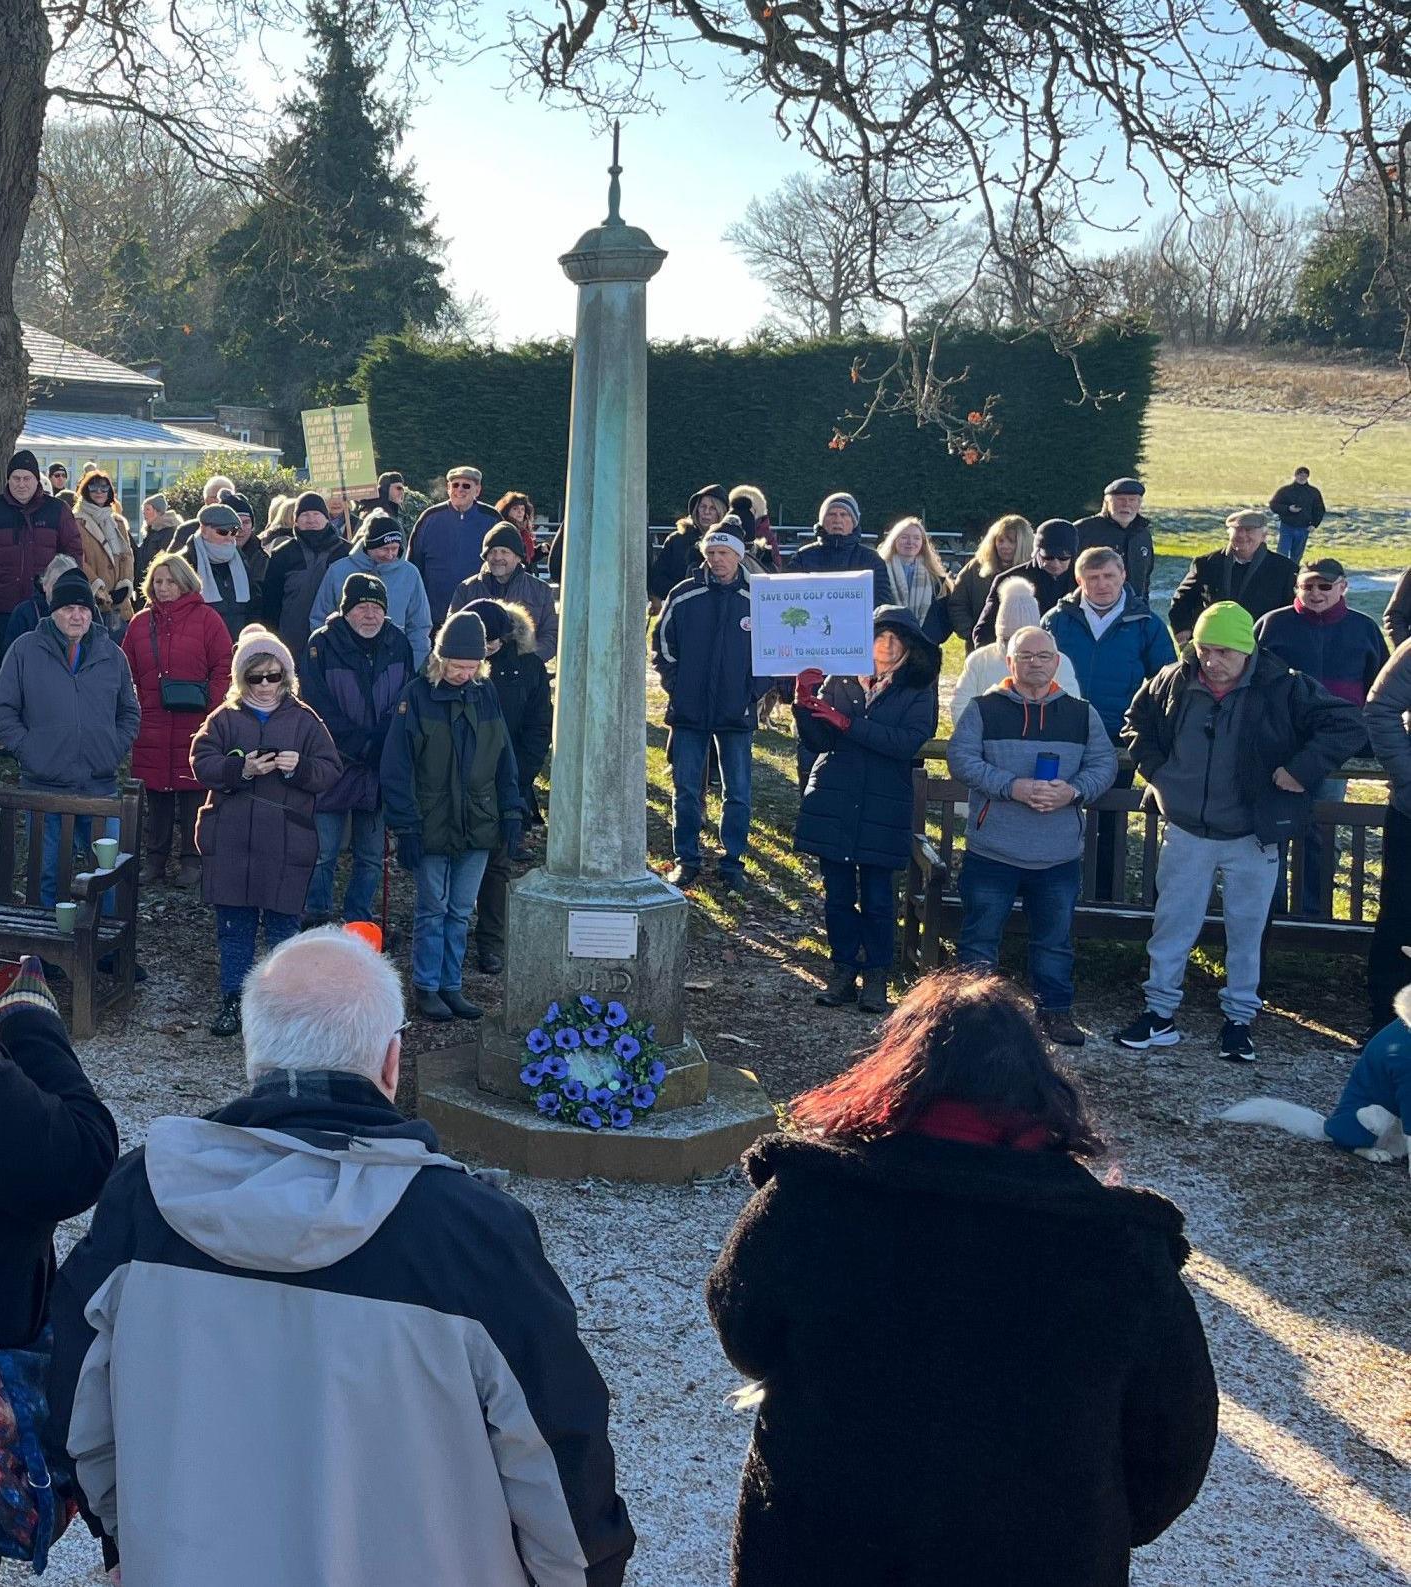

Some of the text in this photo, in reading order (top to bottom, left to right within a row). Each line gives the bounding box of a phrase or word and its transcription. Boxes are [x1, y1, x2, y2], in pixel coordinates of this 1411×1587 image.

[760, 591, 863, 602] SAVE OUR GOLF COURSE!
[763, 645, 864, 657] SAY NO! TO HOMES ENGLAND
